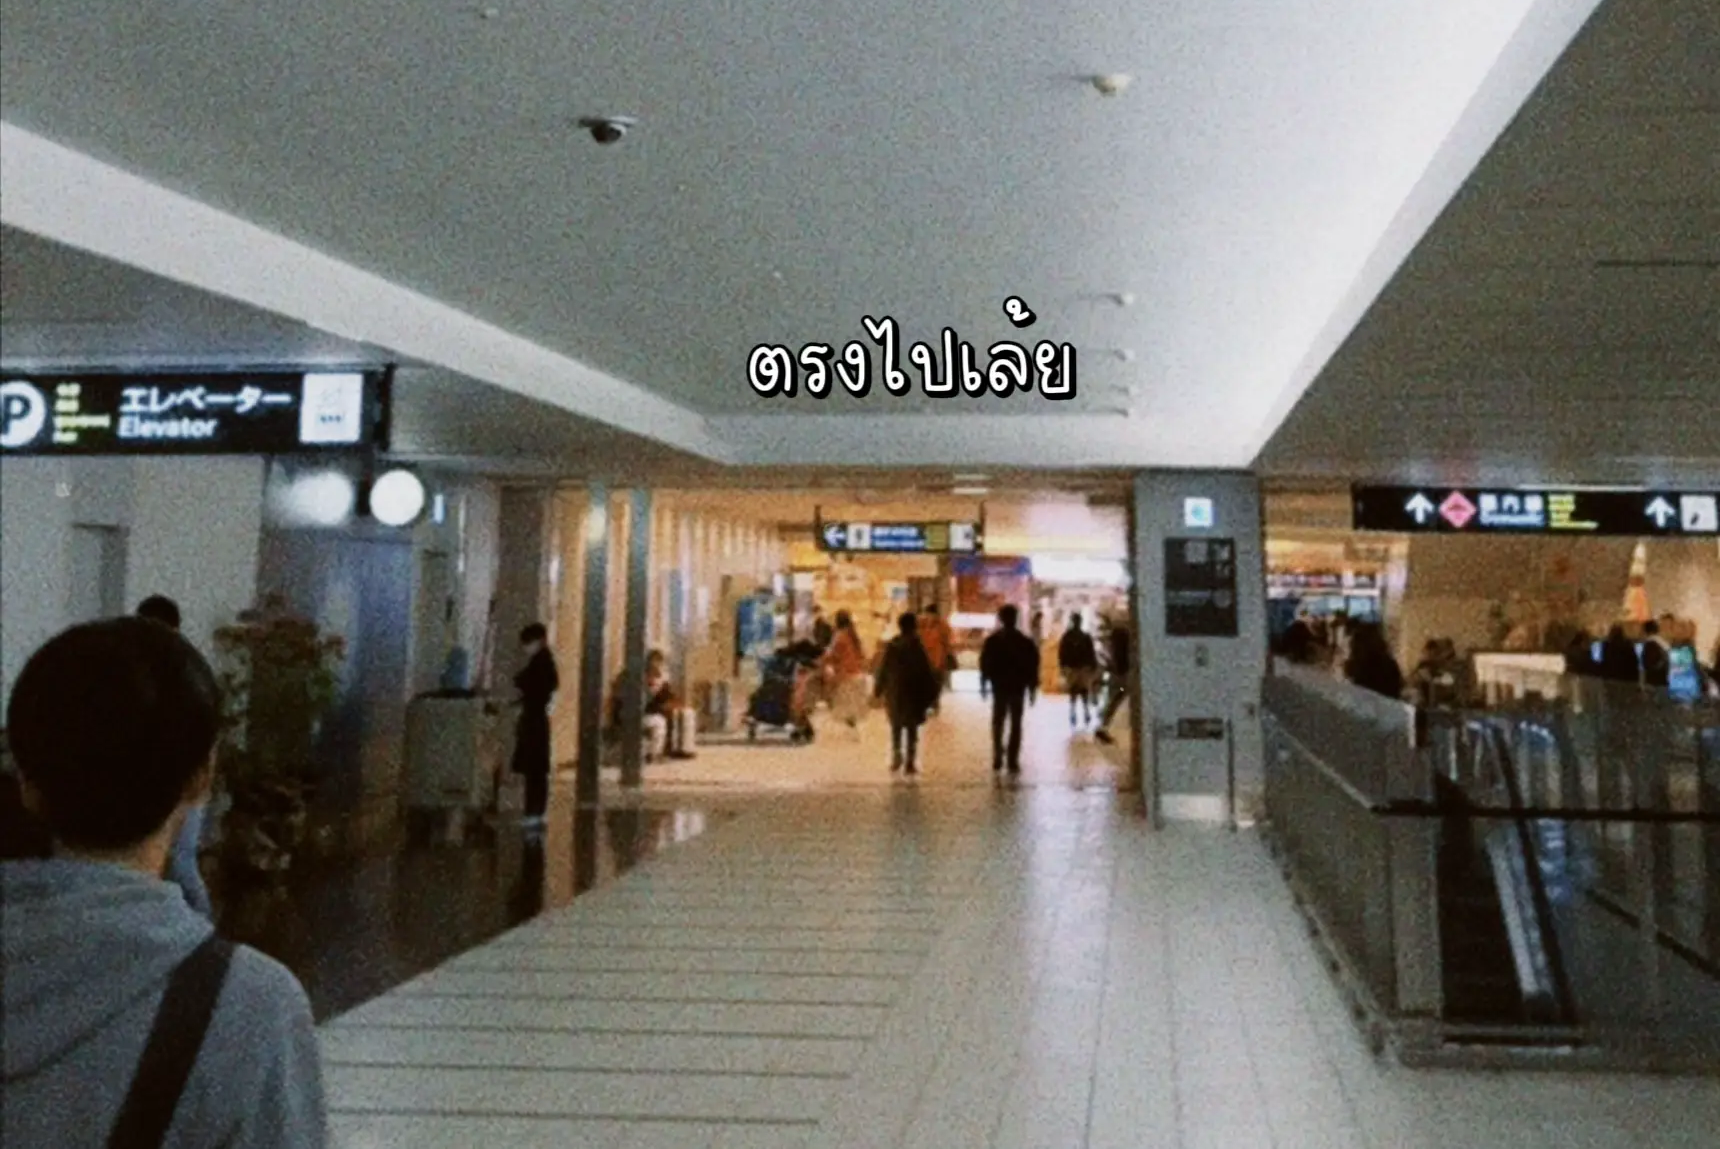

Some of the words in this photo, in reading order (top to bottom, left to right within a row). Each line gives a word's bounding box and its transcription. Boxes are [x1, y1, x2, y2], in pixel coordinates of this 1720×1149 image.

[118, 385, 292, 414] エレベーター
[117, 415, 218, 439] Elevator
